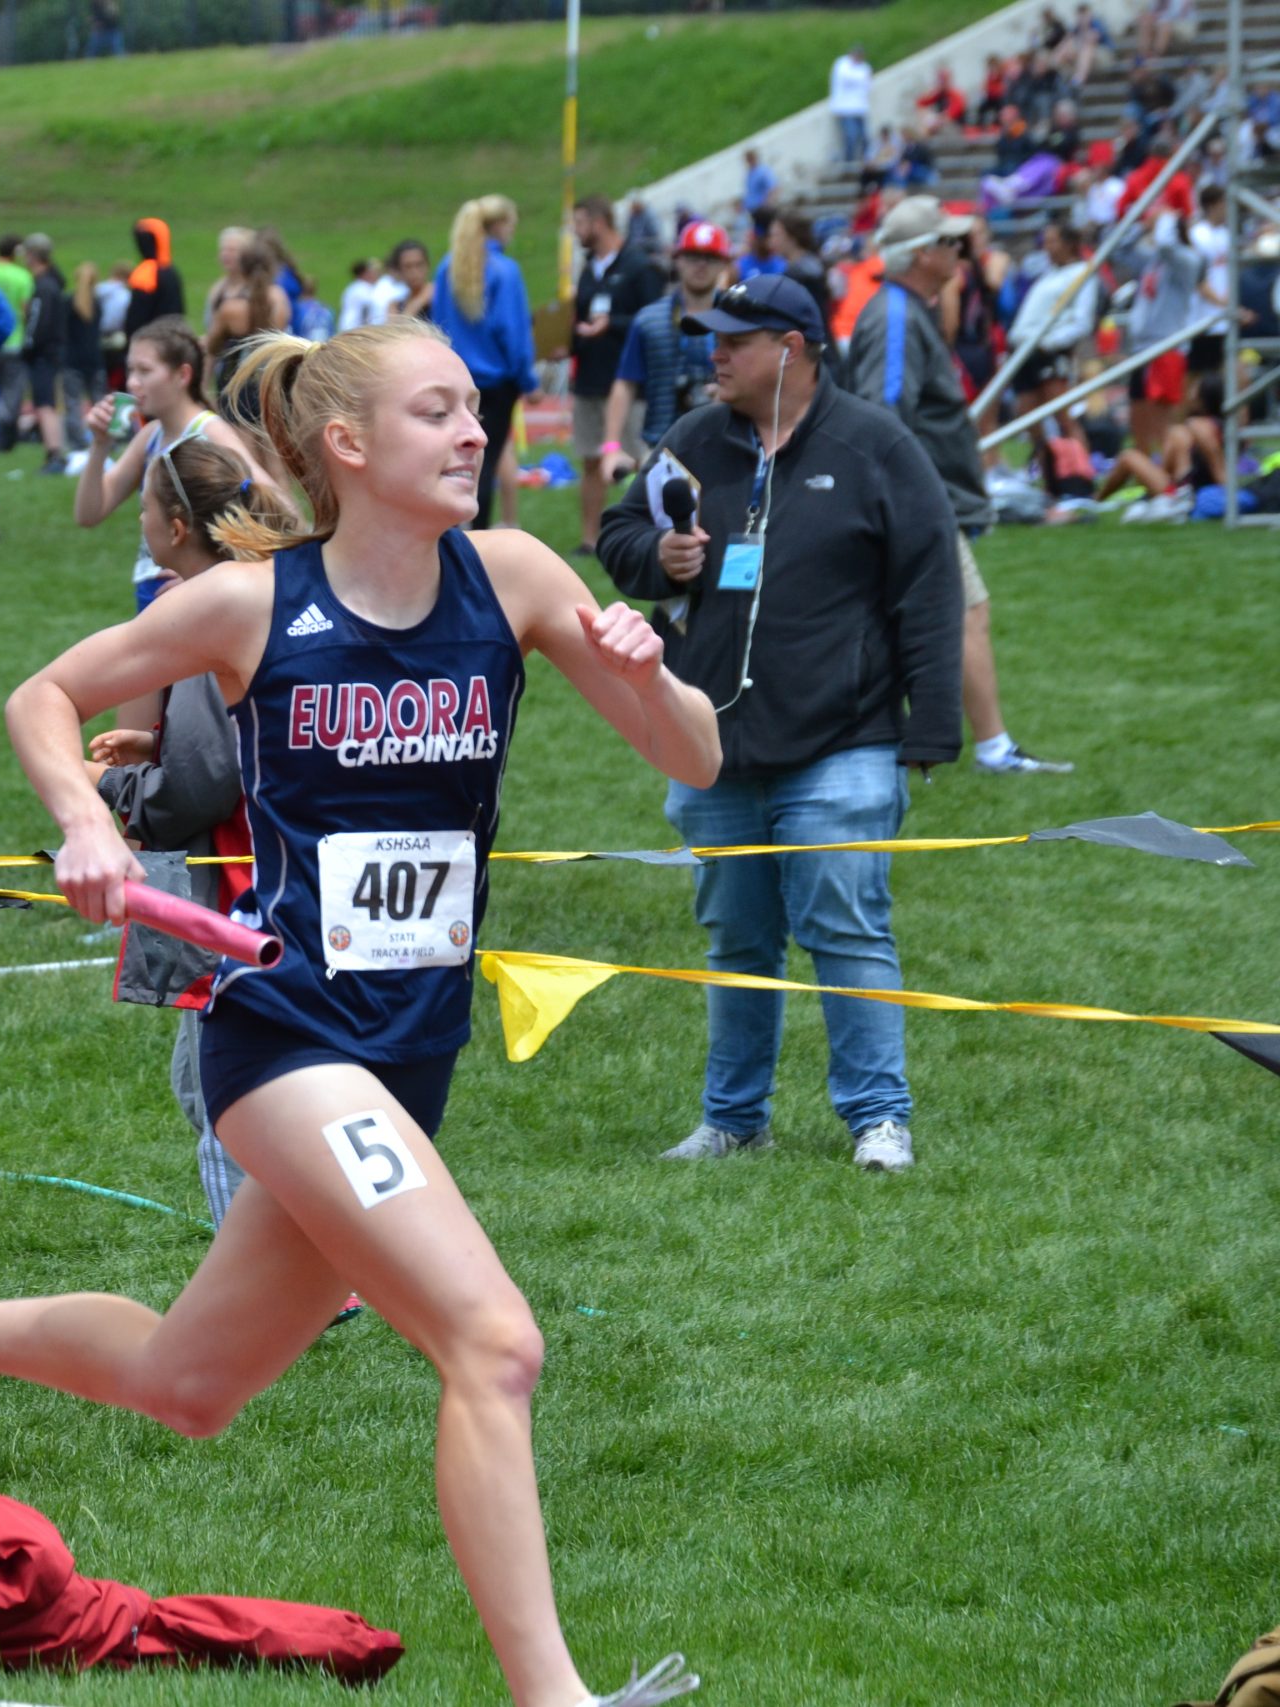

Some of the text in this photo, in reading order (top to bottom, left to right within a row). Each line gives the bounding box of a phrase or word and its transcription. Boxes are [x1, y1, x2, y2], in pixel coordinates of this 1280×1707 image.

[287, 619, 334, 637] adidas
[288, 675, 493, 751] EUDORA
[336, 729, 499, 768] CARDINALS
[375, 836, 432, 852] KSHSAA
[352, 860, 451, 922] 407
[389, 932, 417, 944] STATE
[371, 947, 400, 959] TRACK
[342, 1117, 405, 1195] 5
